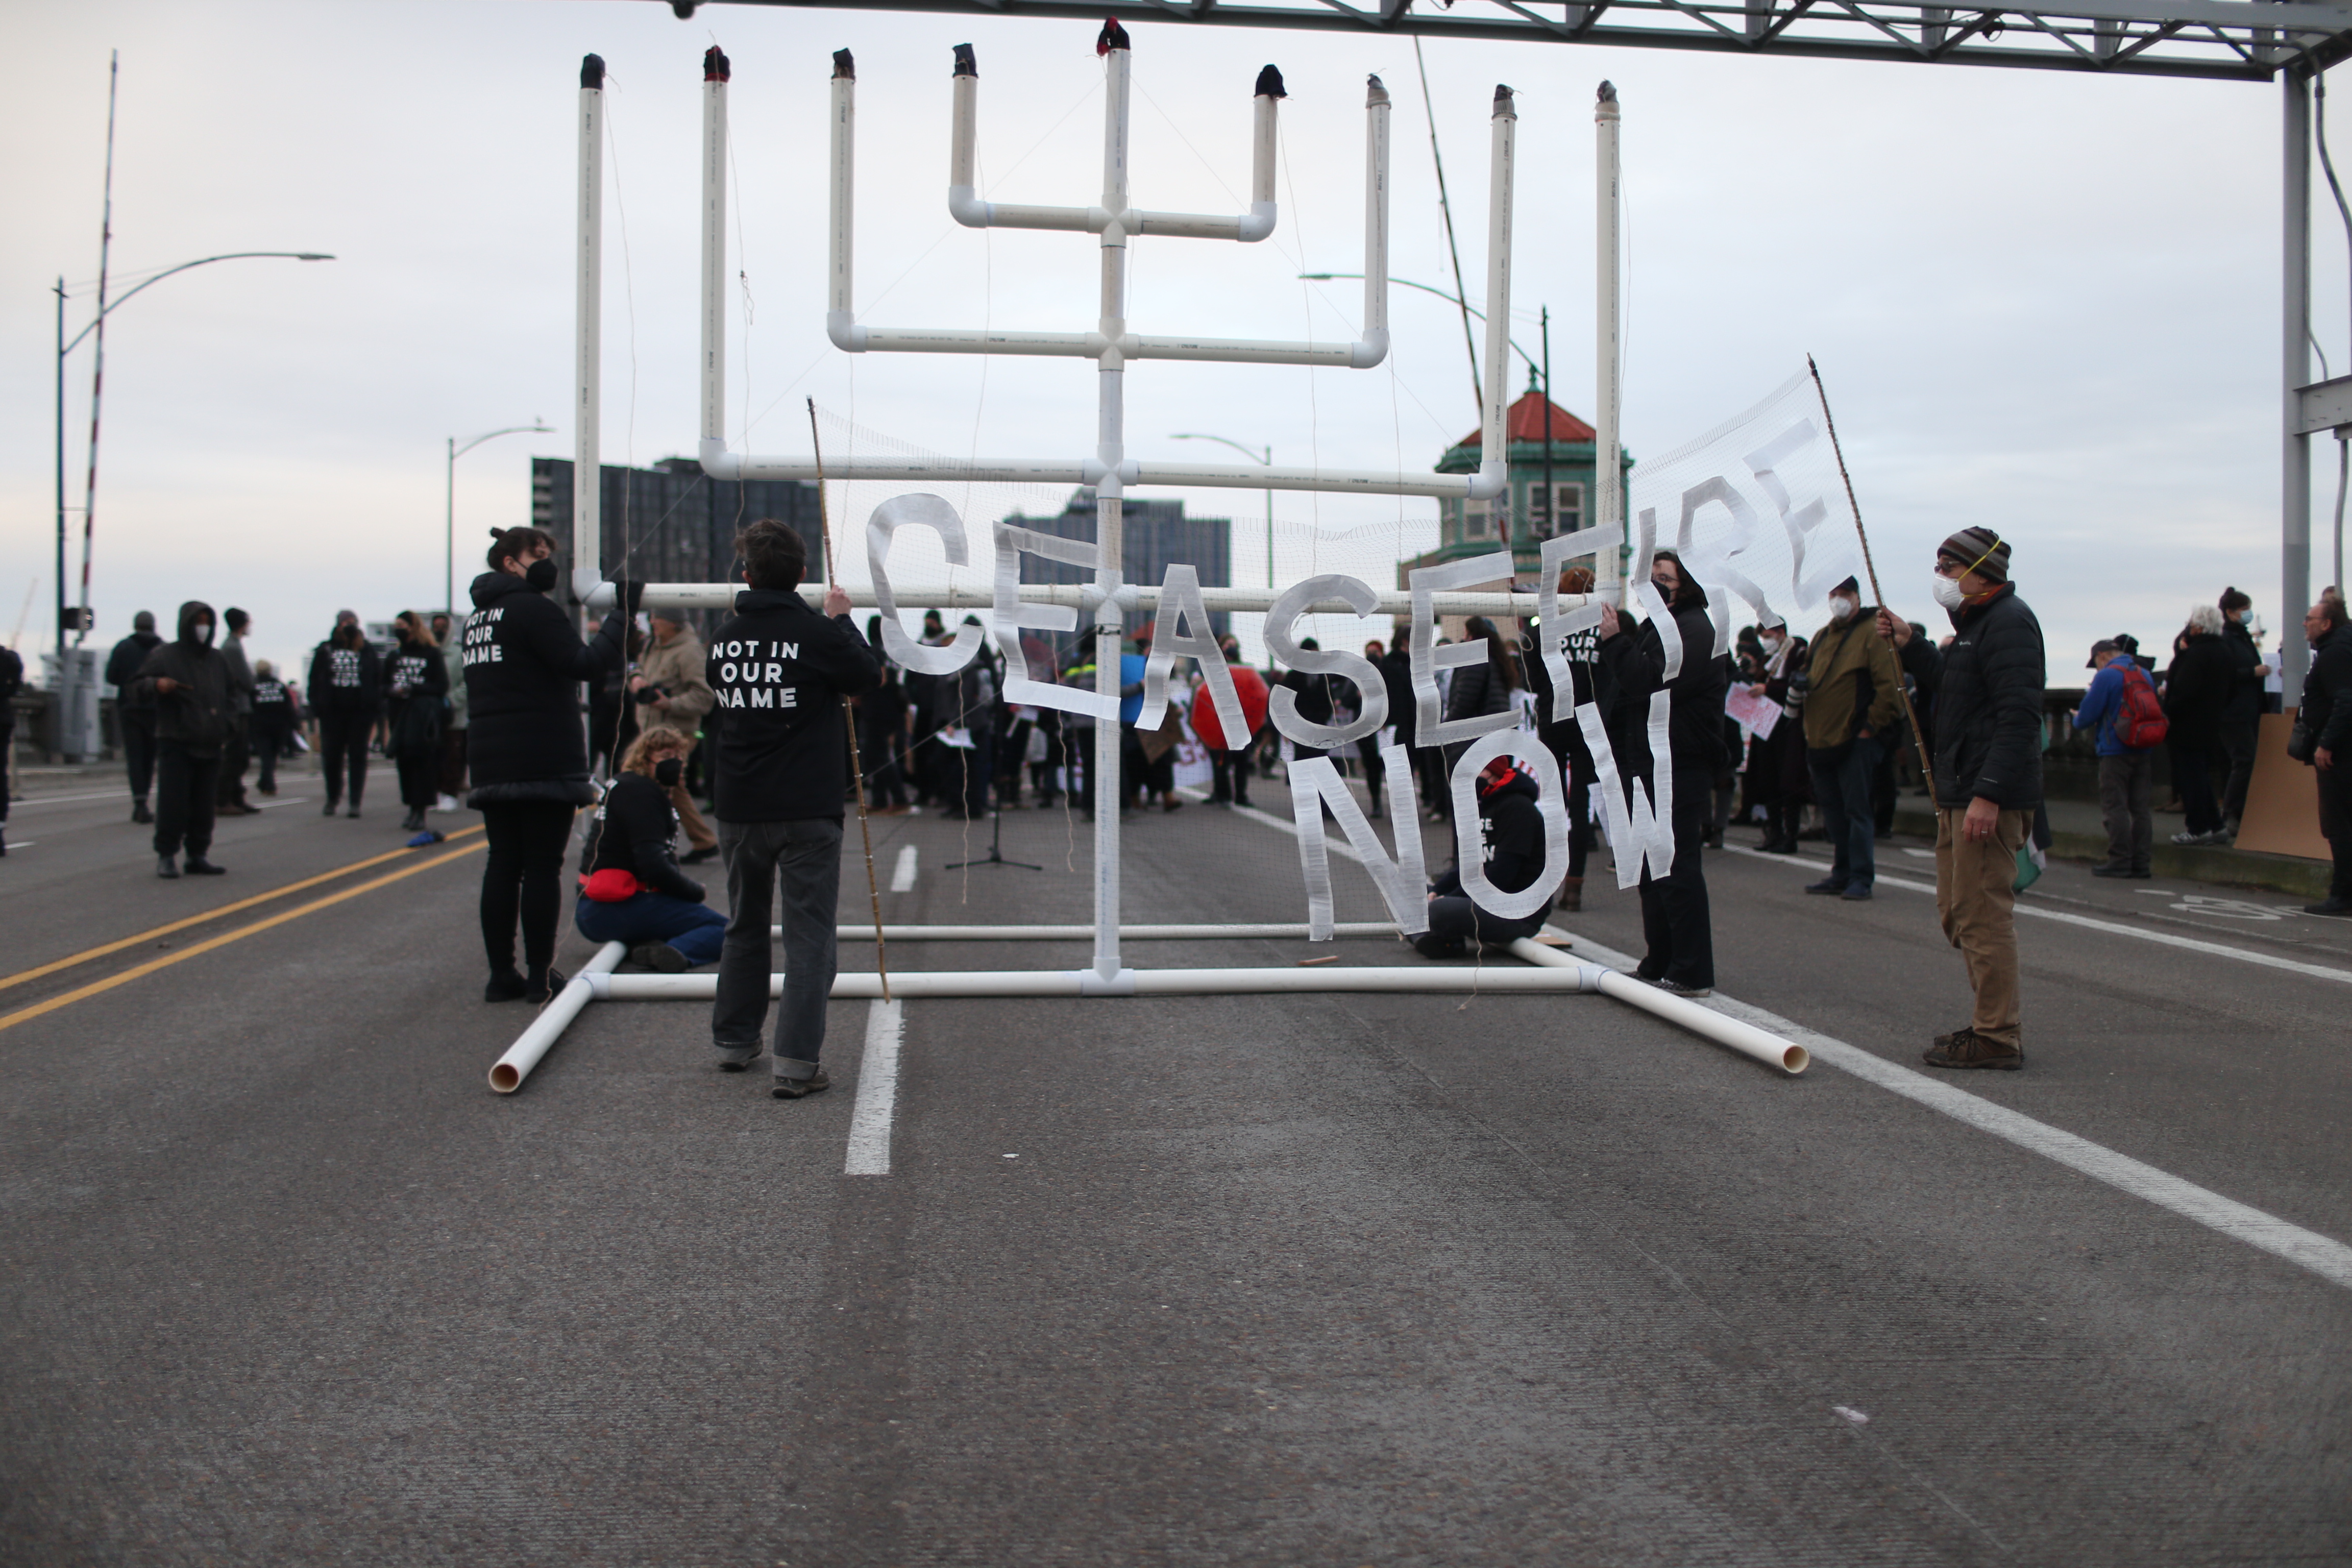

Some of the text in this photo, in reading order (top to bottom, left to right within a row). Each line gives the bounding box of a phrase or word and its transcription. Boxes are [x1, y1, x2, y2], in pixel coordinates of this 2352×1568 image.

[487, 608, 504, 621] IN
[467, 626, 493, 646] OUR
[462, 645, 503, 668] NAME
[713, 641, 799, 659] NOT IN
[1563, 649, 1600, 664] AME
[721, 663, 782, 682] OUR
[716, 688, 797, 708] NAME
[1287, 690, 1676, 941] NOW
